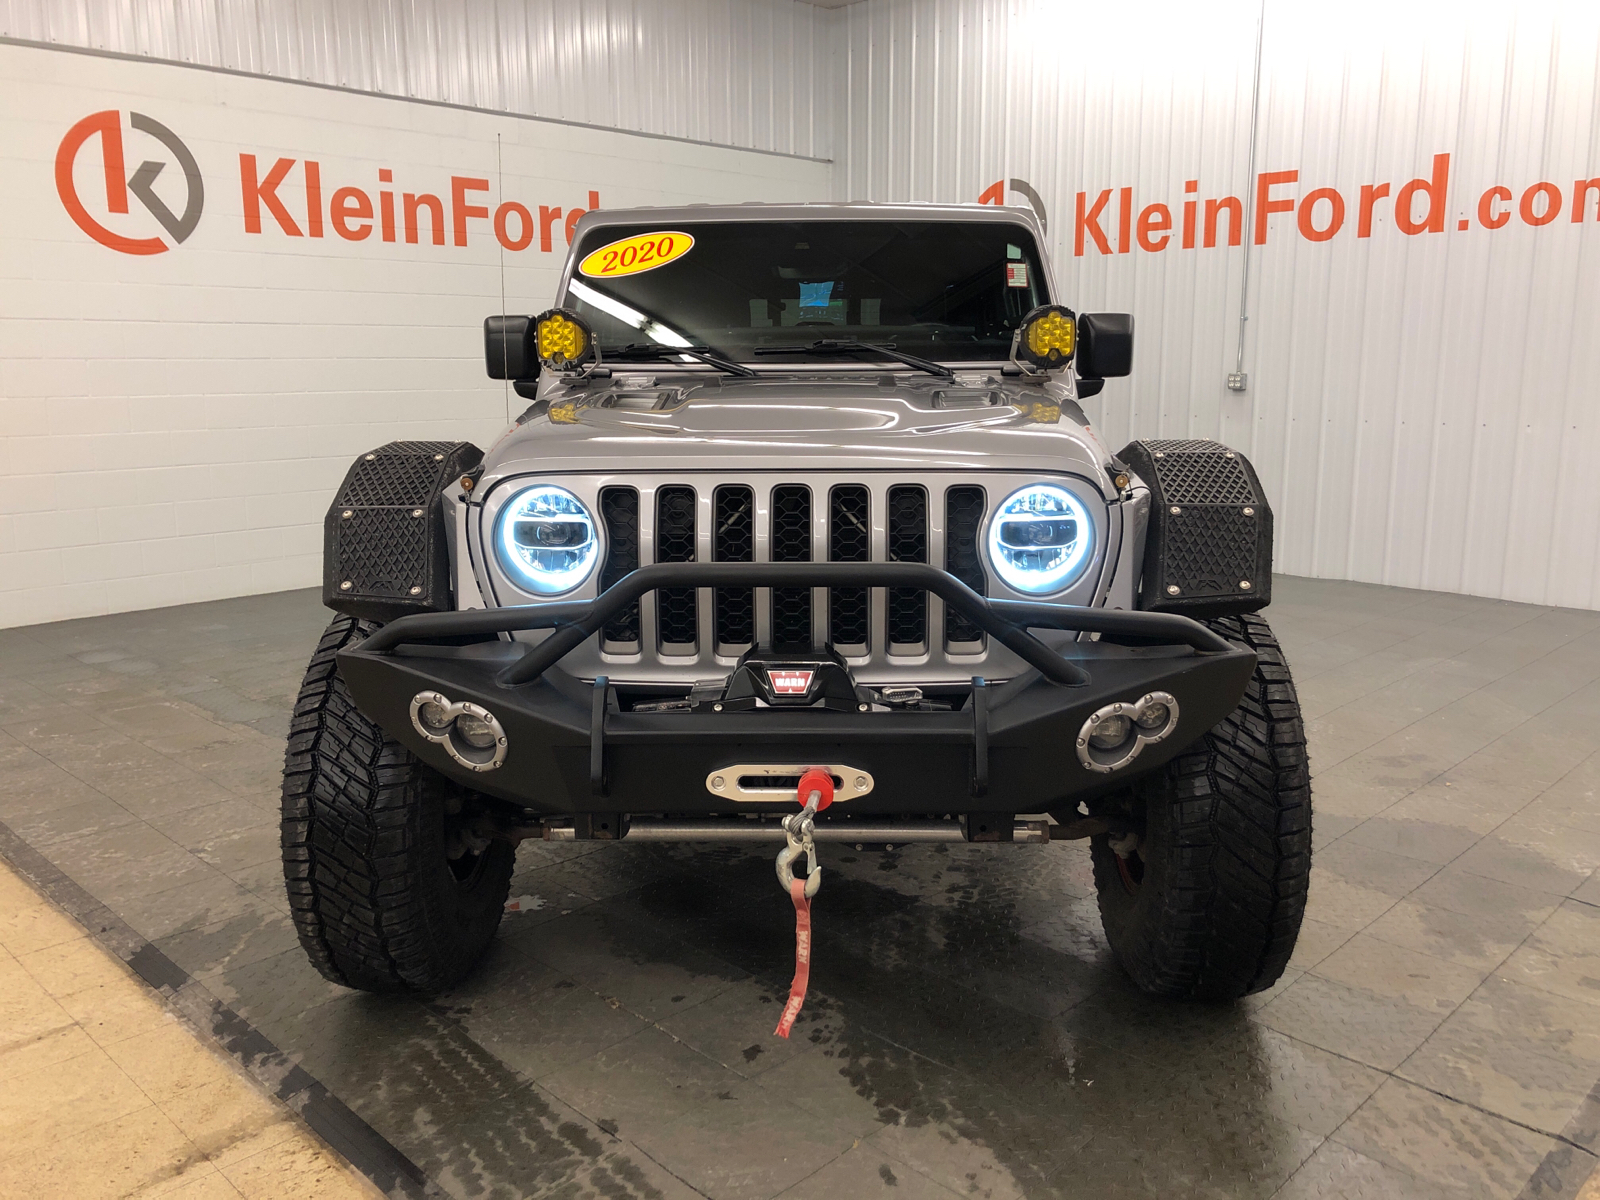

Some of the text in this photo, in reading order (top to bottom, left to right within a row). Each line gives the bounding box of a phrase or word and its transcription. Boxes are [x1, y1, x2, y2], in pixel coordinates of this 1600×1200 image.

[600, 236, 674, 274] 2020
[775, 677, 806, 687] WARN
[798, 930, 809, 964] WARN
